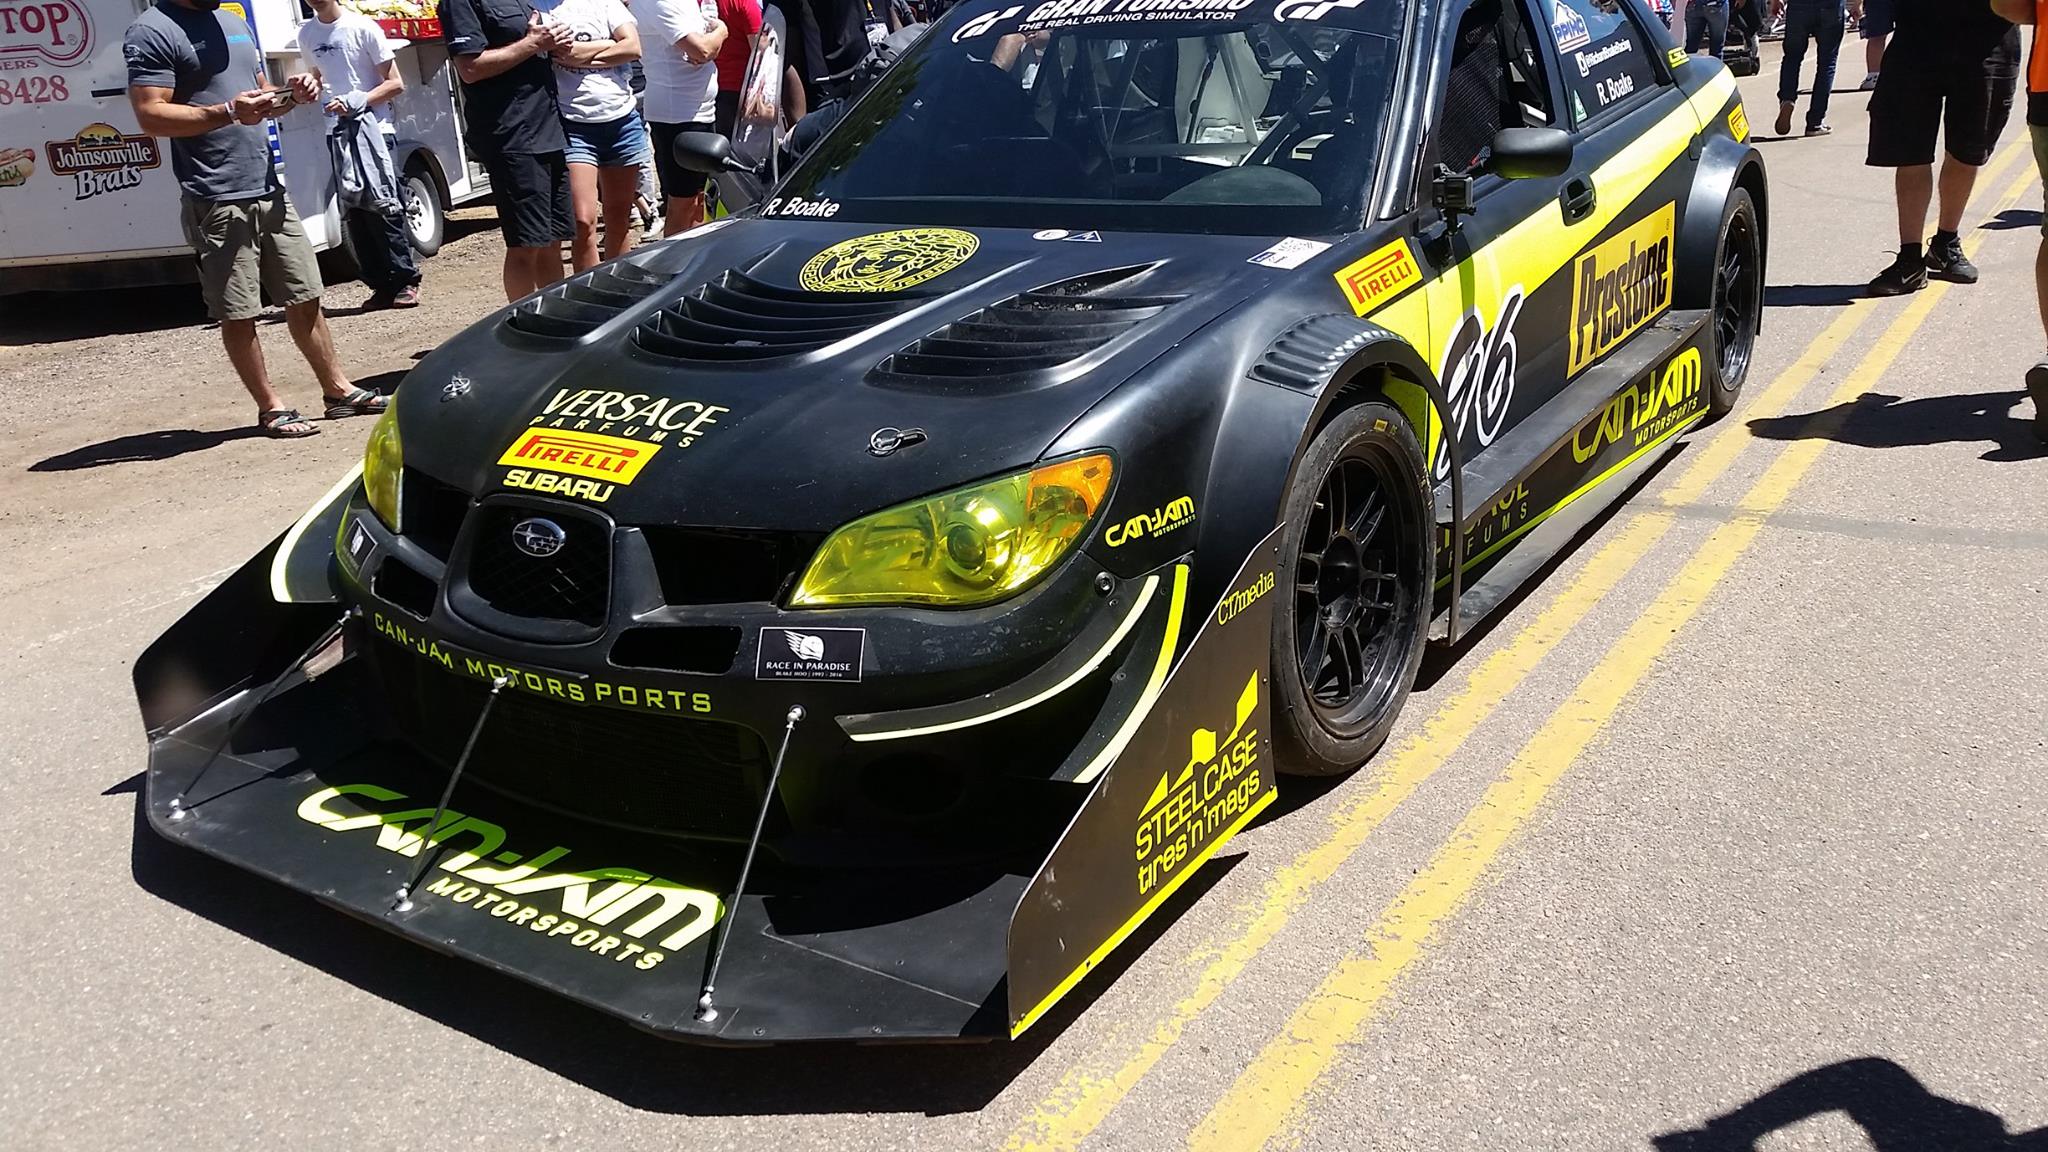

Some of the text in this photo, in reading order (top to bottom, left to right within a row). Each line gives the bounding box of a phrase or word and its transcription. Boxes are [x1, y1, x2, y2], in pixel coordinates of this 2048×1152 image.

[1017, 11, 1237, 32] THE REAL DRIVING SIMULATOR
[1026, 0, 1105, 22] GRAN
[0, 60, 39, 71] ERS
[1606, 72, 1635, 102] Boake
[56, 142, 153, 169] Johnsonville
[75, 164, 143, 200] Brats
[762, 196, 840, 218] R. Boake
[1346, 249, 1413, 305] PIRELLI
[1575, 235, 1670, 367] Prestone
[542, 388, 730, 436] VERSACE
[1634, 396, 1698, 447] MOTORSPORTS
[528, 416, 695, 448] PARFUMS
[515, 435, 640, 474] PIRELLI
[503, 469, 615, 503] SUBARU
[1153, 513, 1197, 538] MOTORSPORTS
[1218, 571, 1275, 625] C17media
[374, 613, 453, 669] CAN-JAM
[766, 661, 852, 671] RACE IN PARADISE
[1136, 728, 1258, 861] STEELCASE
[426, 876, 666, 971] MOTORSPORTS
